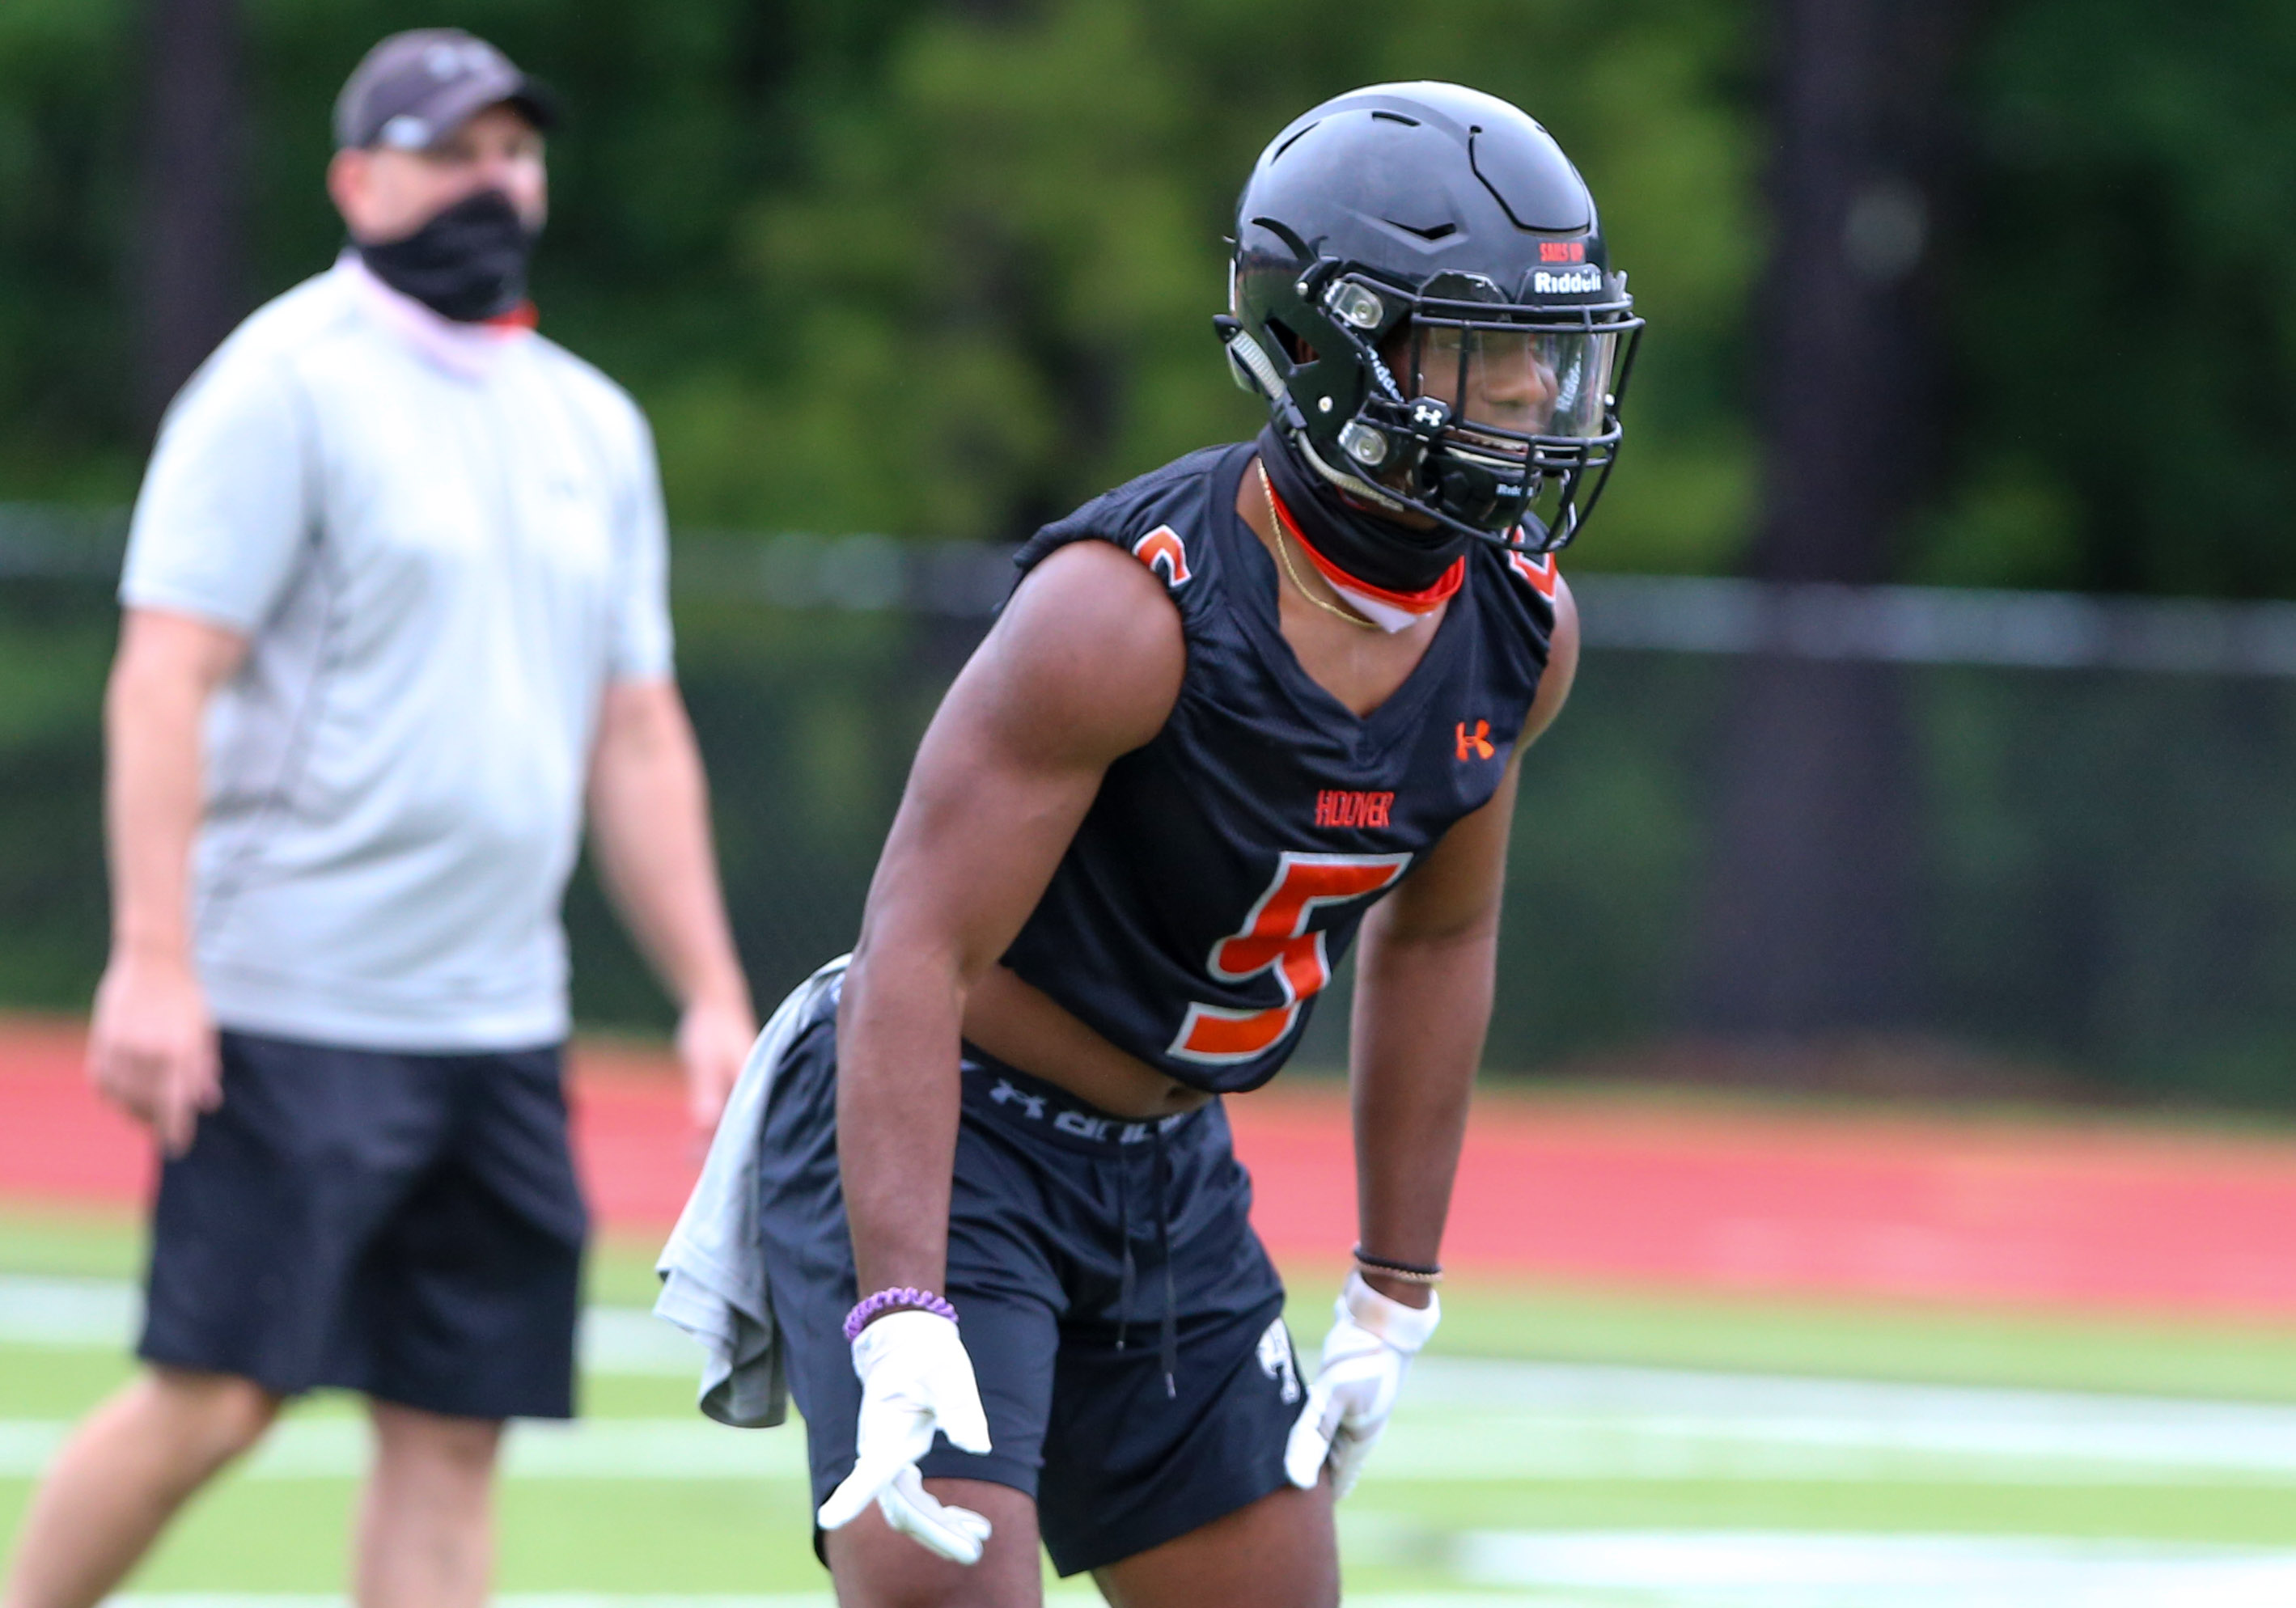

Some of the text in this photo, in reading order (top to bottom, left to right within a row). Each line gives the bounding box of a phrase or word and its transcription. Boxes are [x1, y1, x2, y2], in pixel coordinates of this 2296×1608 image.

[1535, 272, 1602, 293] Riddell
[1315, 789, 1395, 828] HOOVER
[1166, 851, 1413, 1066] 5
